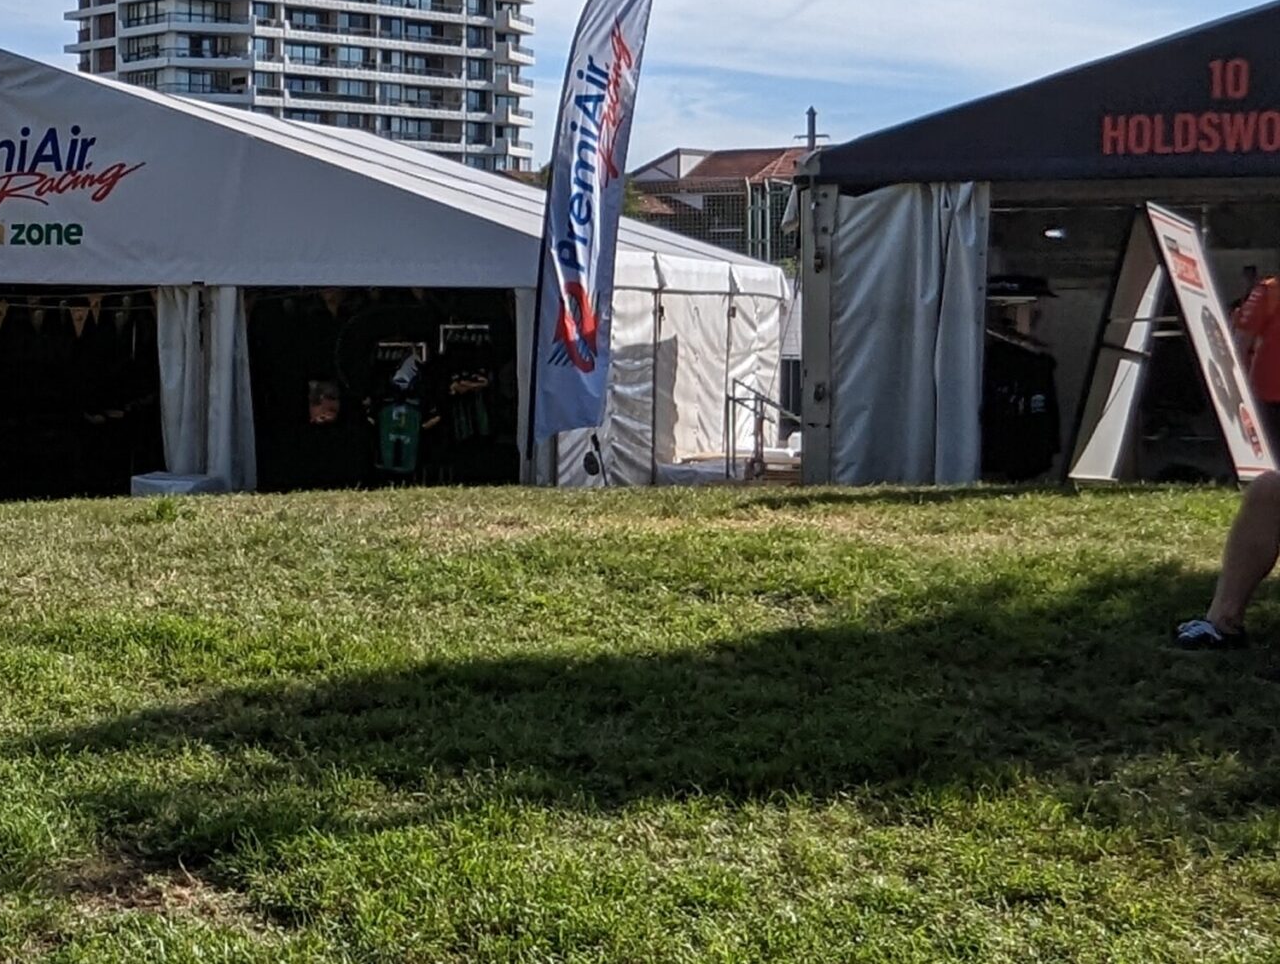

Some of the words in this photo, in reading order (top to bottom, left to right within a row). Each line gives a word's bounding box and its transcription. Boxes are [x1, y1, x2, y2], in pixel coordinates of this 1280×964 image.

[1209, 57, 1250, 100] 10
[1101, 110, 1280, 155] HOLDSWO
[557, 54, 610, 272] PremiAir
[10, 223, 84, 246] zone
